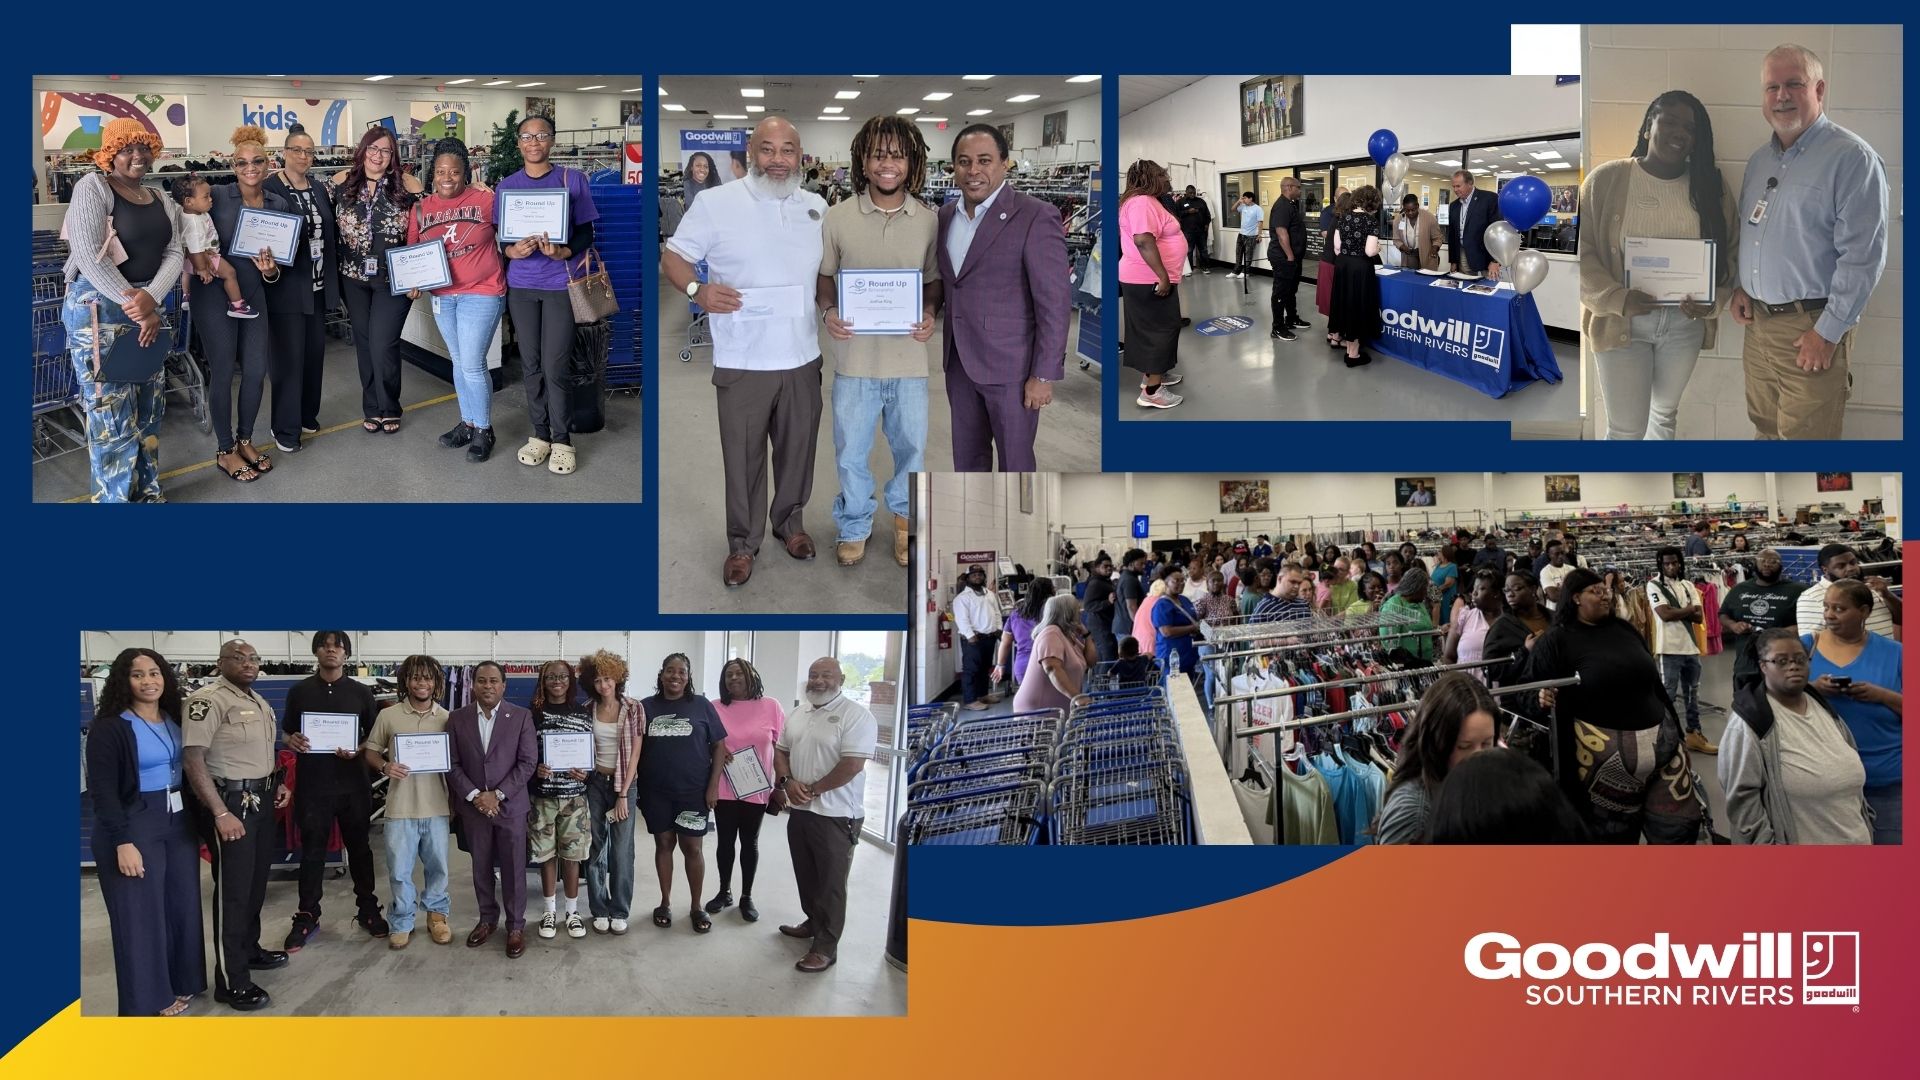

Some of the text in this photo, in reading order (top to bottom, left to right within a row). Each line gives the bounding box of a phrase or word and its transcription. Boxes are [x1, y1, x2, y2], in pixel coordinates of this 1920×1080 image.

[242, 104, 298, 131] kids
[685, 131, 732, 141] Goodwill
[868, 280, 907, 288] Round Up
[1379, 308, 1471, 346] odwill
[1381, 325, 1469, 358] UTHERN RIVERS
[1136, 519, 1145, 533] 1
[1651, 593, 1660, 603] 3
